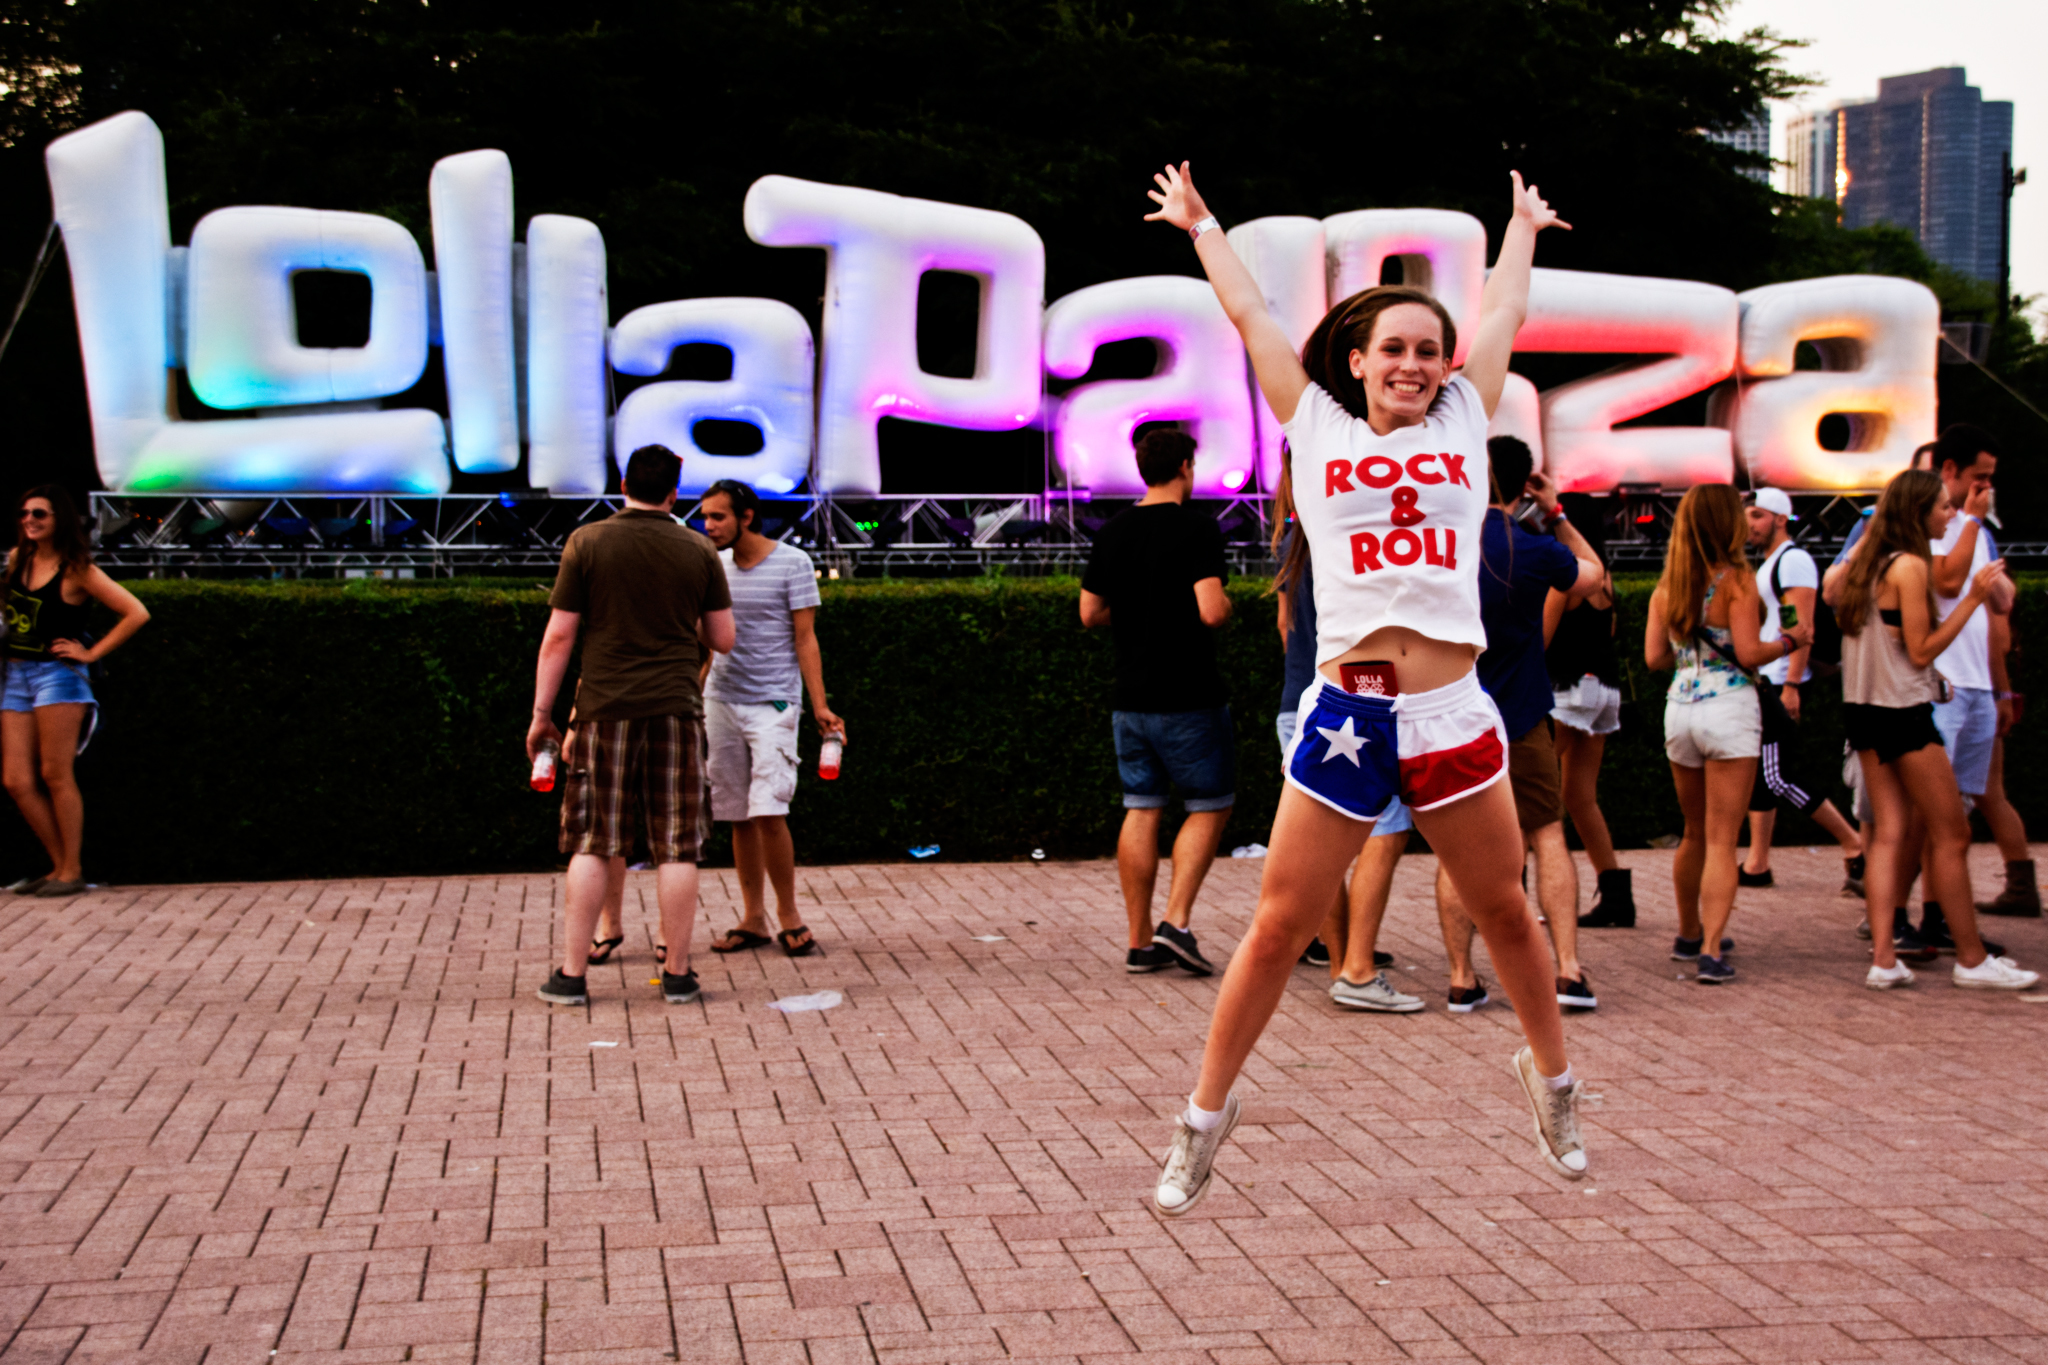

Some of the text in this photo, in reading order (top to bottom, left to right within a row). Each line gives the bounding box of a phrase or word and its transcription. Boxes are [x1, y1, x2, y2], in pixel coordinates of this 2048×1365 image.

[1325, 452, 1472, 499] ROCK
[1389, 485, 1427, 528] &
[1348, 527, 1457, 576] ROLL
[1354, 674, 1384, 684] LOLLA
